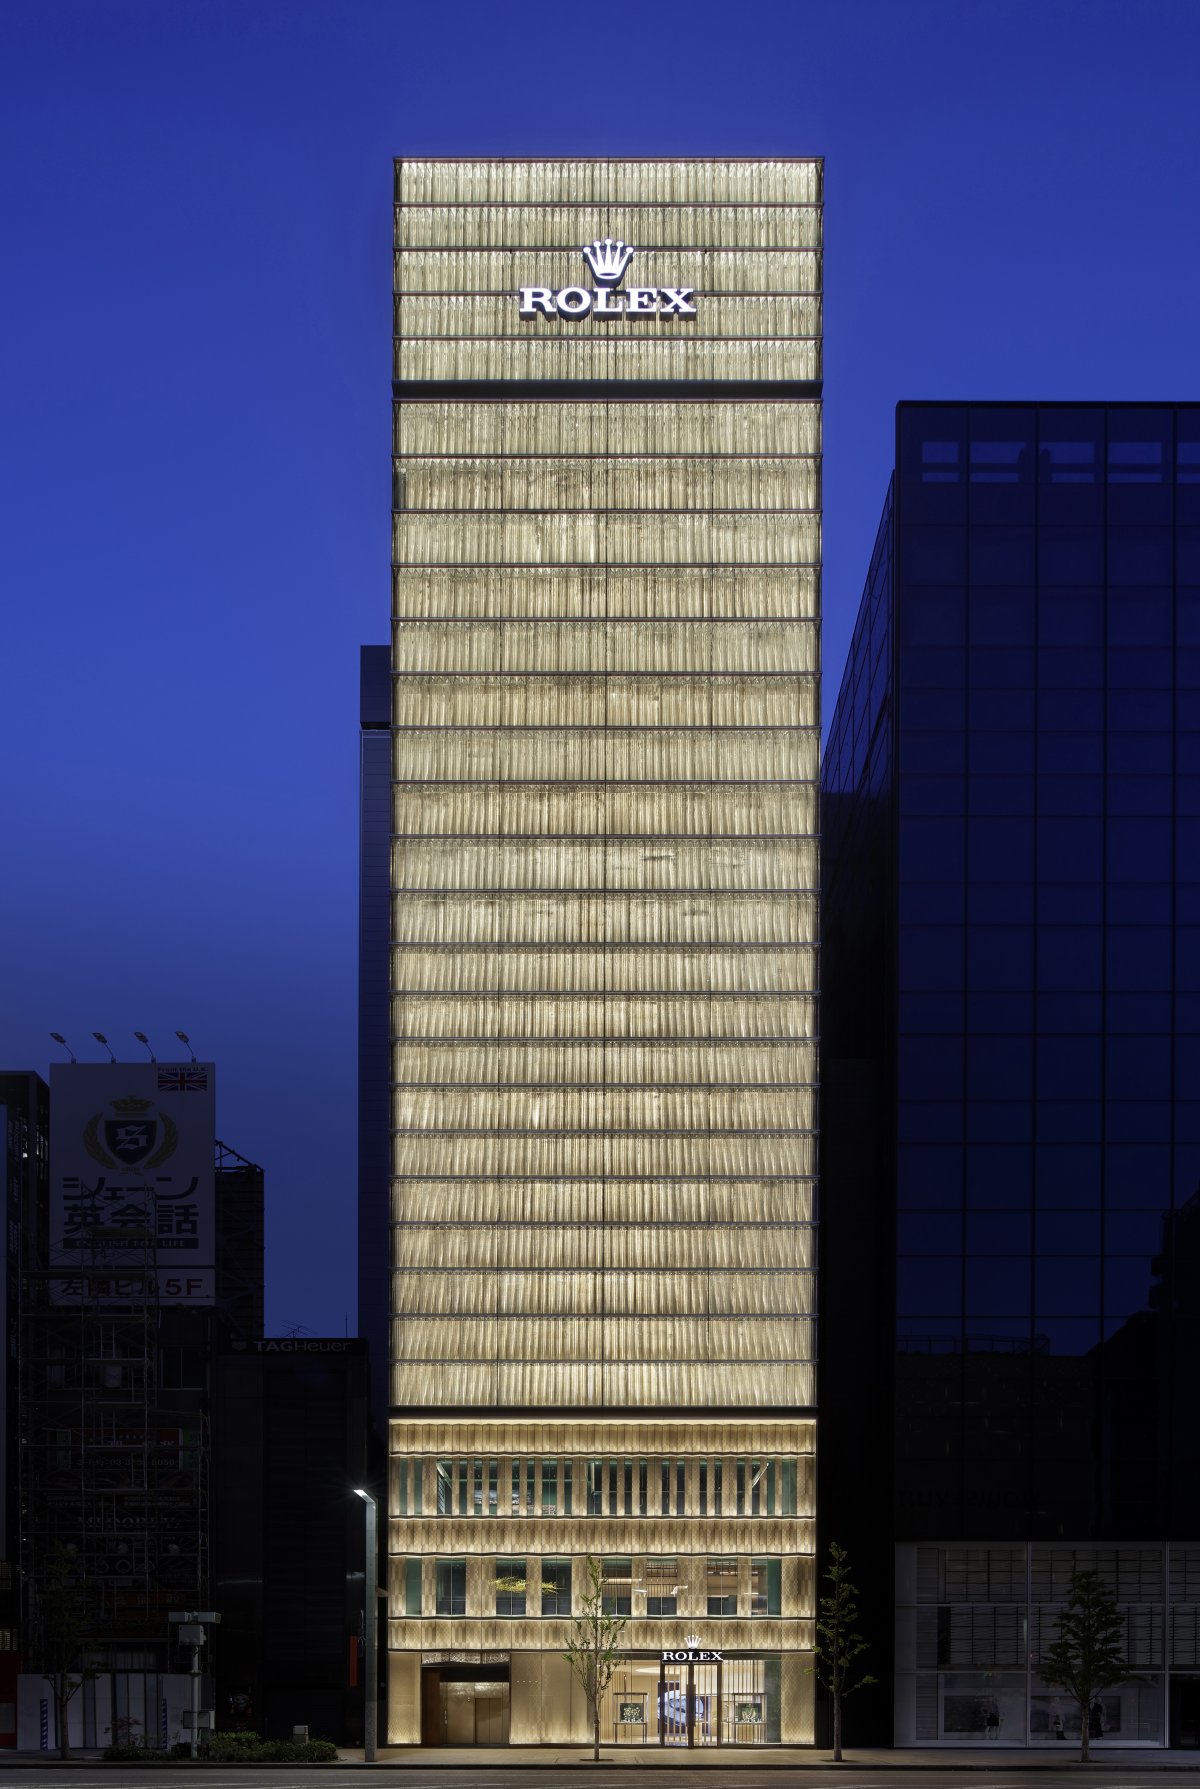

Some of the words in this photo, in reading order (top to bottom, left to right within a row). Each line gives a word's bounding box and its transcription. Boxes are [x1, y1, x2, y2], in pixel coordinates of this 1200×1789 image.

[519, 287, 697, 314] ROLEX
[62, 1176, 200, 1201] シェーン
[161, 1239, 186, 1248] LIFE
[165, 1278, 203, 1296] 5F
[662, 1651, 724, 1661] ROLEX
